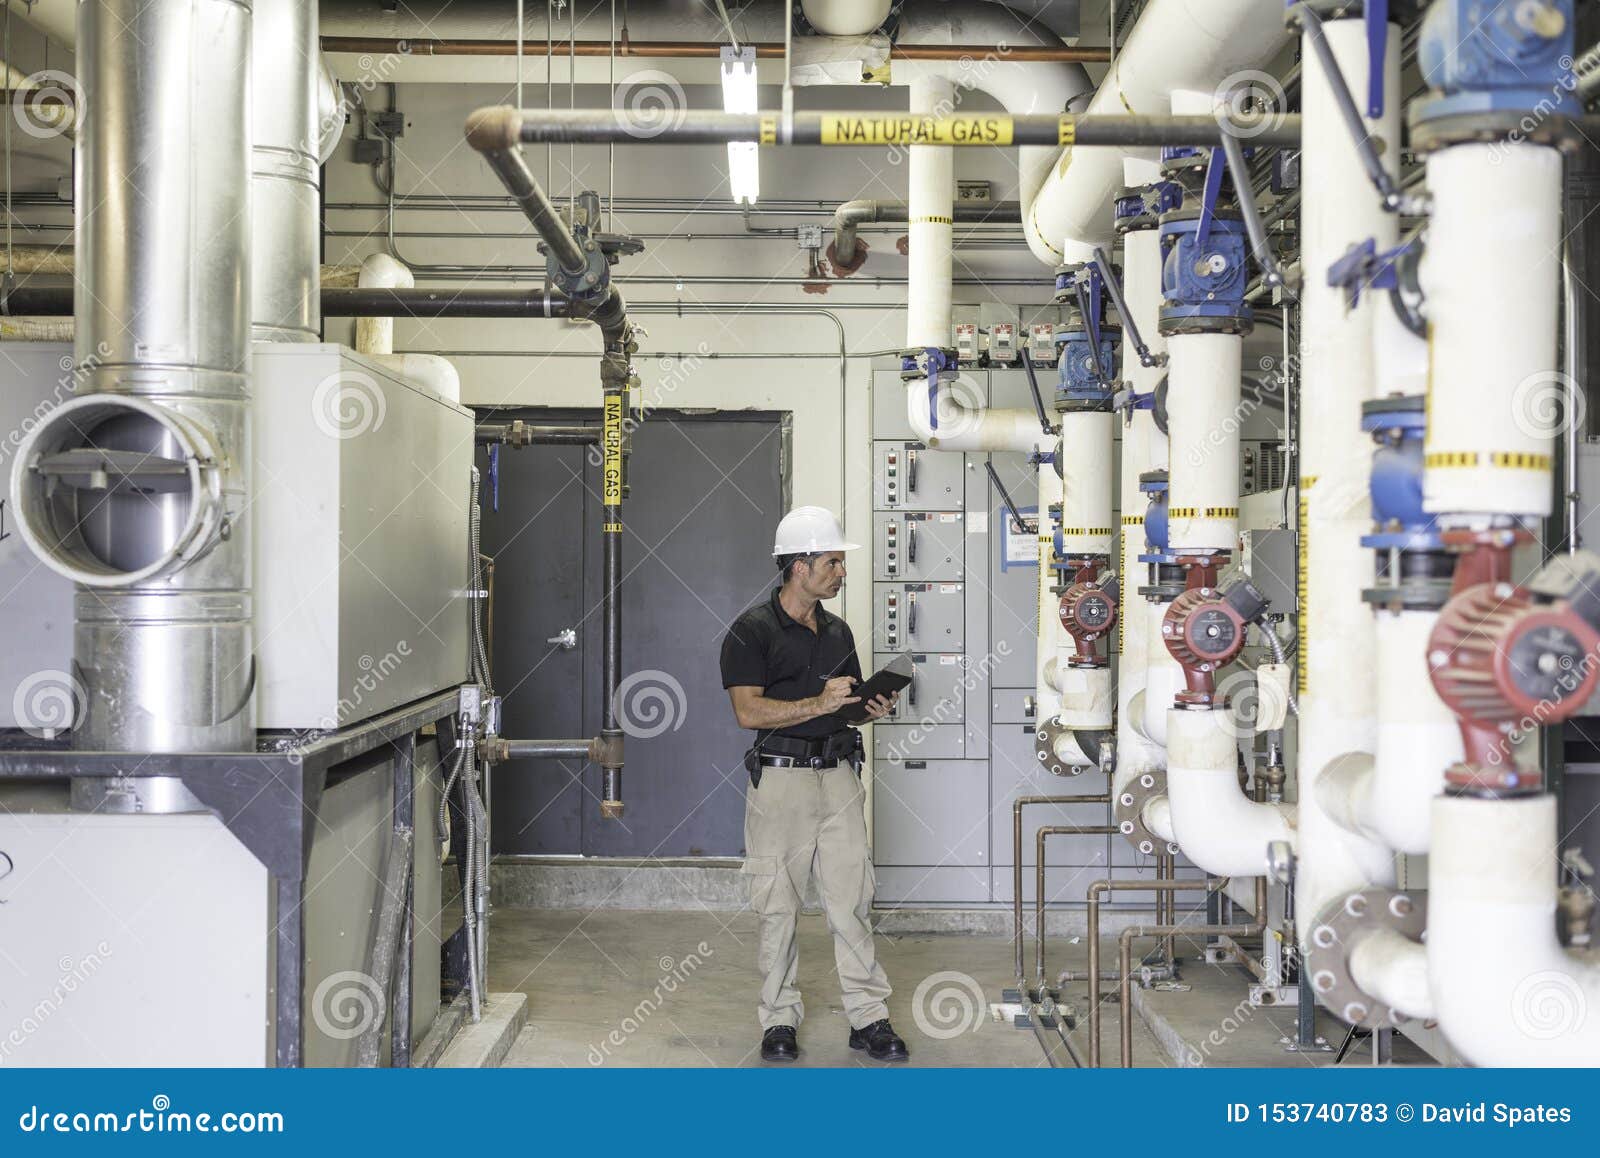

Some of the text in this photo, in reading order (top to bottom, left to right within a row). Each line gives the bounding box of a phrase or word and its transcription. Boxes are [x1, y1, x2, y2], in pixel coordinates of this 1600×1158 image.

[836, 119, 999, 142] NATURAL GAS
[605, 403, 620, 498] NATURAL GAS
